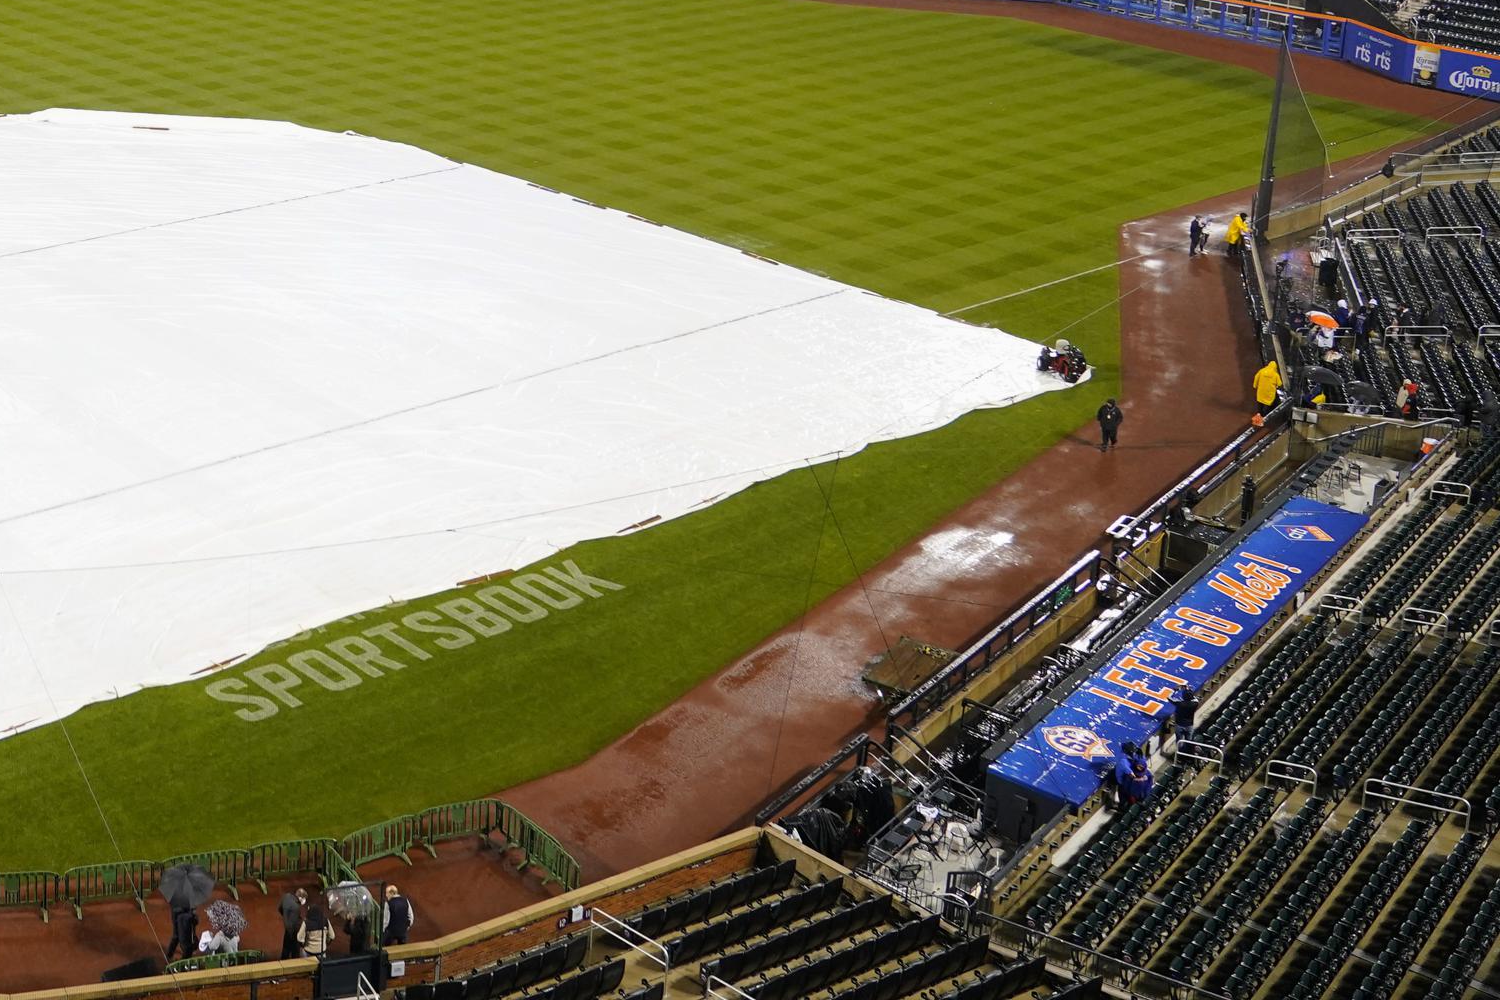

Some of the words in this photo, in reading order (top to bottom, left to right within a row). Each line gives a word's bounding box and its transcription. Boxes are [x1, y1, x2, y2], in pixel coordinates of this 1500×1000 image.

[205, 559, 626, 722] SPORTSBOOK
[1088, 641, 1207, 717] LET'S
[1162, 606, 1243, 648] GO
[1207, 551, 1303, 616] Mets!
